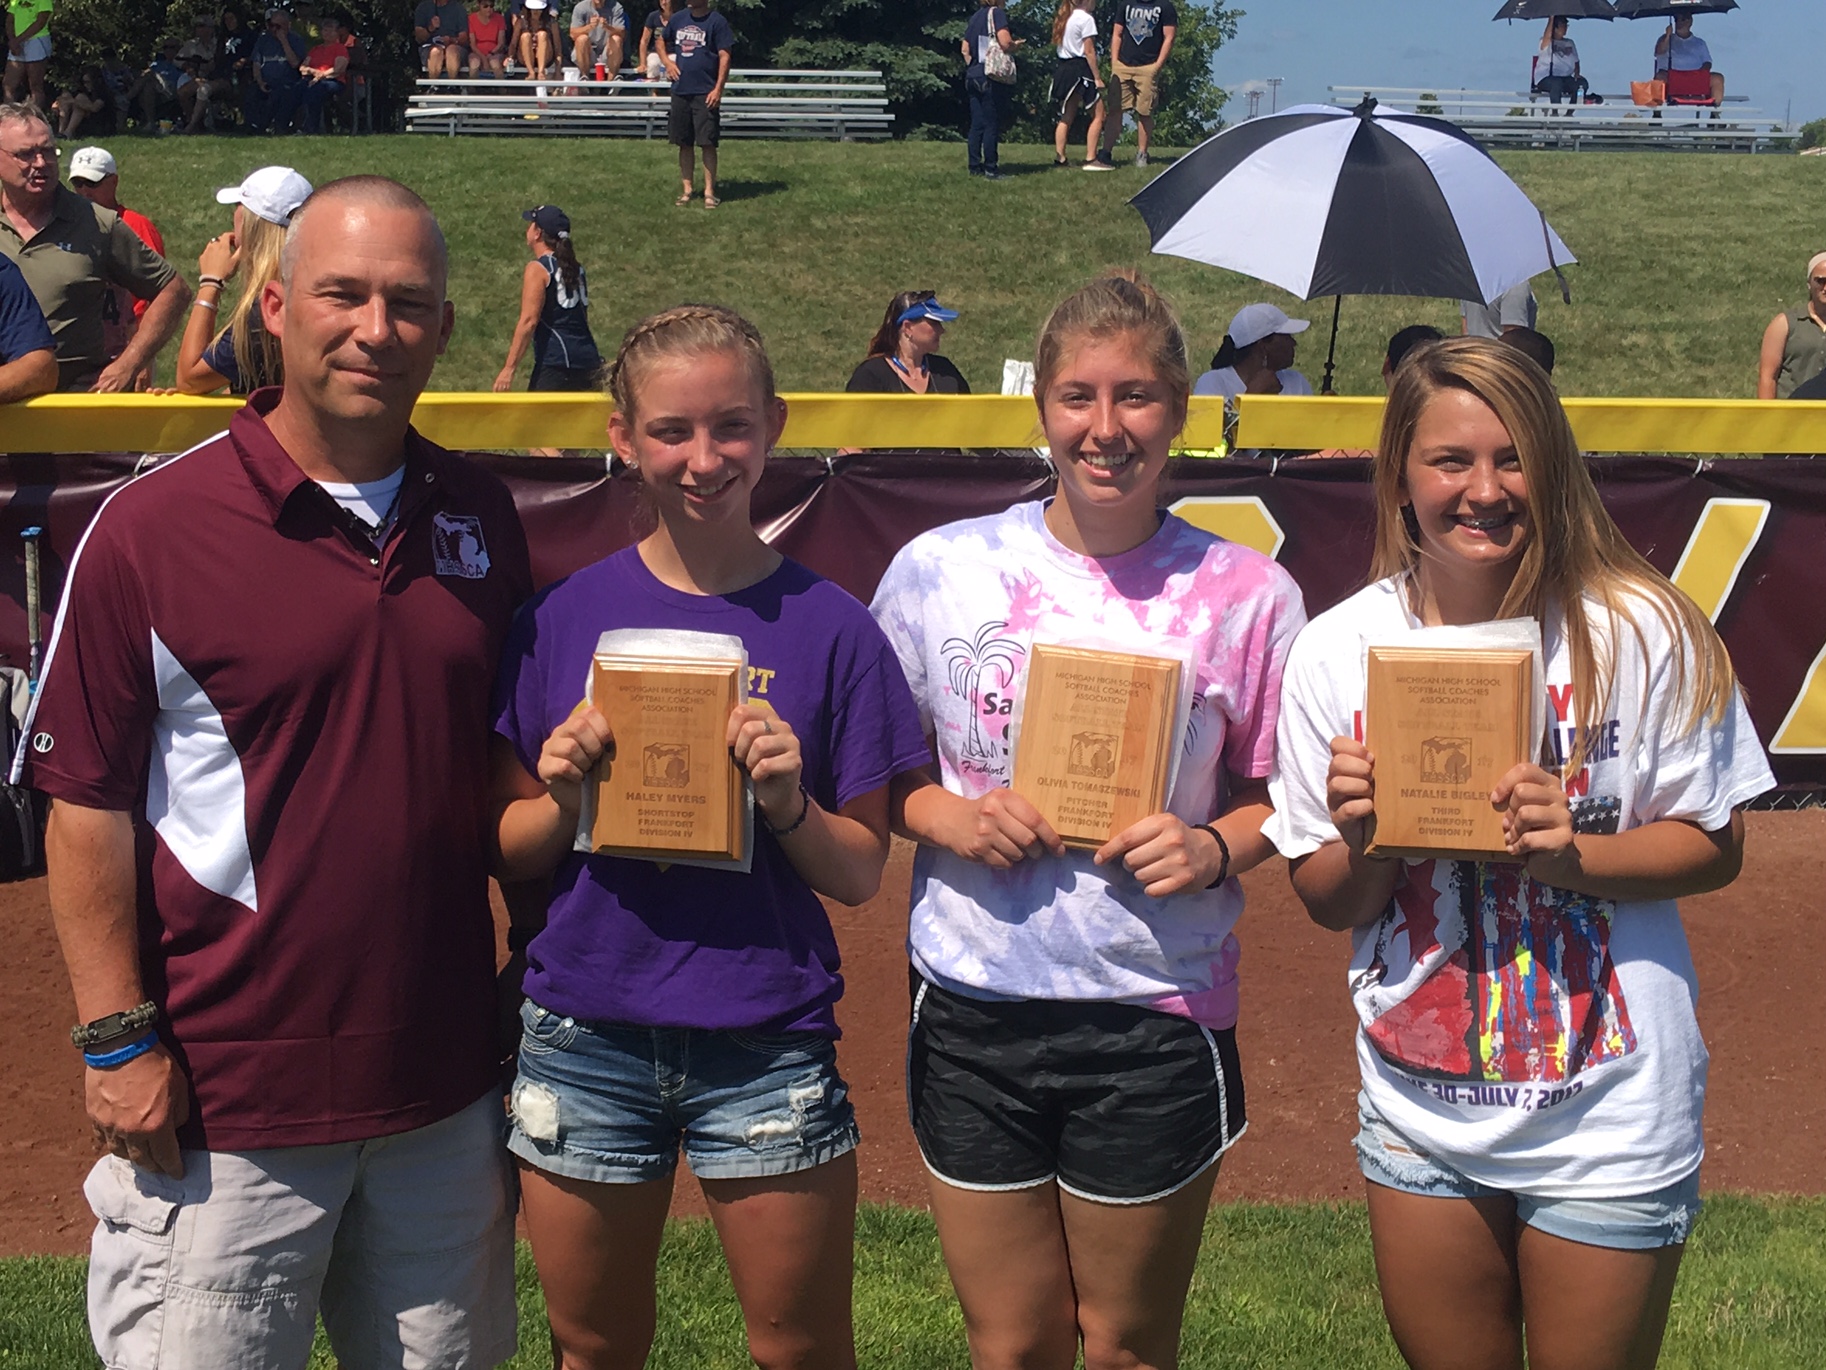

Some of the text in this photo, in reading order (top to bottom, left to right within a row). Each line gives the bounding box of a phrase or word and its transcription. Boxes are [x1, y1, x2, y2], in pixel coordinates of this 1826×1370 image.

[1125, 4, 1161, 24] LIONS
[1055, 672, 1151, 690] MICHIGAN HIGH SCHOOL
[1396, 676, 1502, 687] MICHIGAN HIGH SCHOOL
[619, 685, 717, 697] MICHIGAN HIGH SCHOOL
[1065, 682, 1139, 698] SOFTBALL COACHES
[1408, 686, 1489, 696] SOFTBALL COACHES
[629, 695, 705, 705] SOFTBALL COACHES
[1075, 693, 1127, 705] ASSOCIATION
[1420, 696, 1477, 705] ASSOCIATION
[641, 705, 693, 714] ASSOCIATION
[1037, 777, 1140, 798] OLIVIA TOMASZEWSKI
[626, 791, 706, 805] HALEY MYERS
[1400, 788, 1492, 801] NATALIE BIGLEY
[1066, 797, 1108, 809] PITCHER
[638, 809, 695, 819] SHORTSTOP
[1057, 805, 1115, 819] FRANKFORT
[1431, 806, 1461, 815] THIRD
[638, 818, 694, 828] FRANKFORT
[1057, 816, 1112, 829] DIVISION IV
[1417, 817, 1474, 827] FRANKFORT
[639, 828, 693, 838] DIVISION IV
[1418, 827, 1473, 837] DIVISION IV
[1432, 1082, 1520, 1107] 30-JULY
